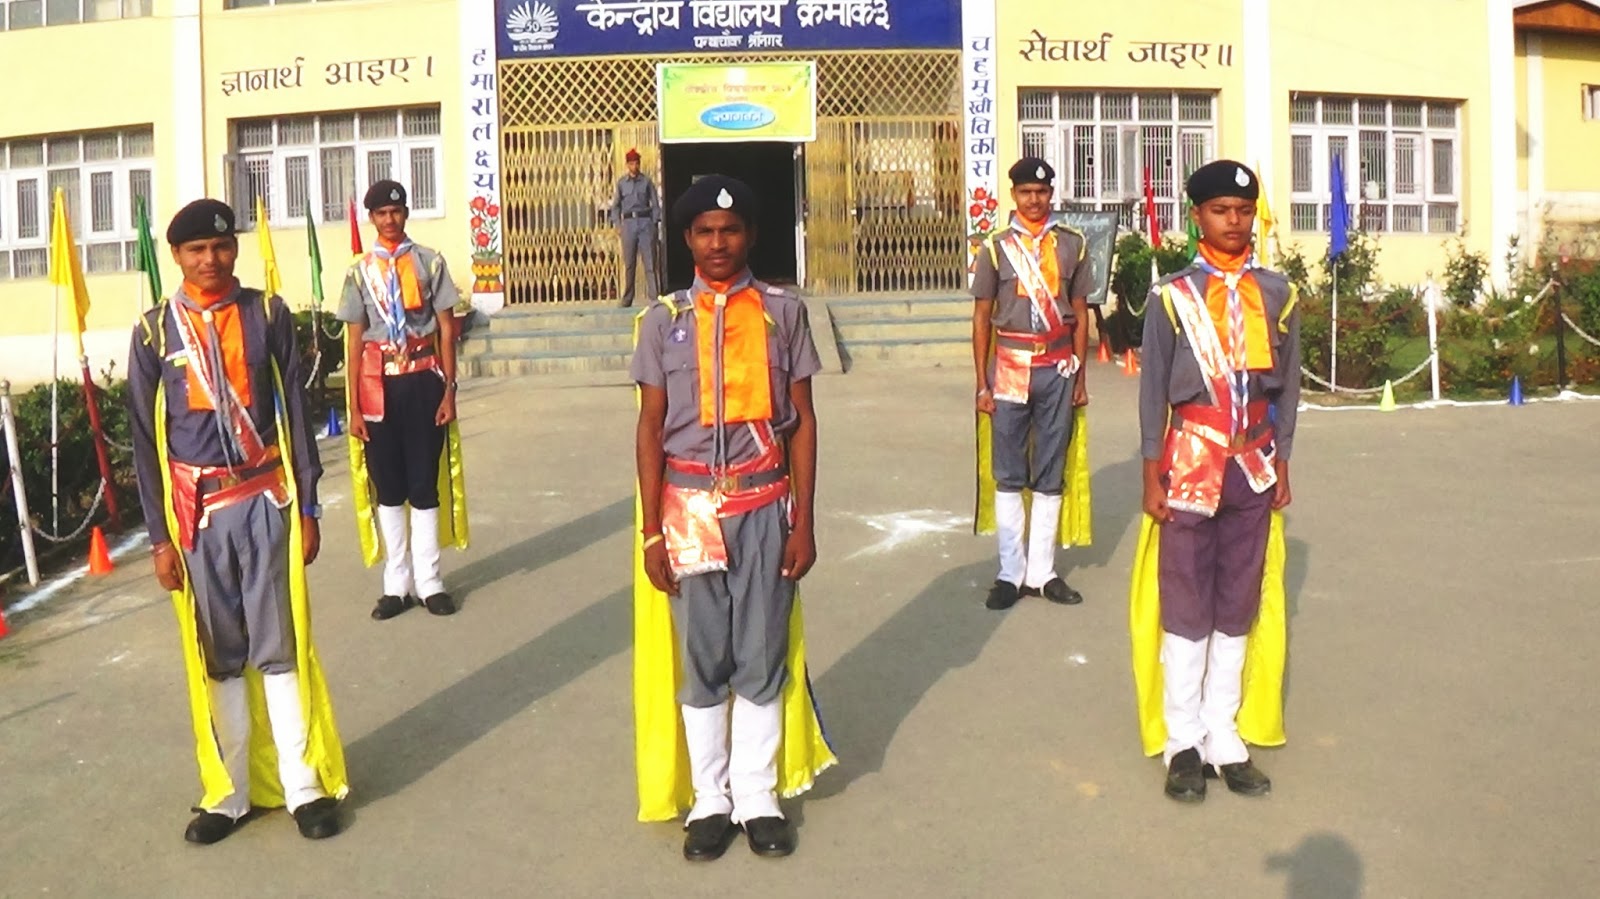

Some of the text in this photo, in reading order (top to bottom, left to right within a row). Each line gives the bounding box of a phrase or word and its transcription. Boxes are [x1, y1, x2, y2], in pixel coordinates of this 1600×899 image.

[748, 31, 783, 48] श्रीनगर
[1019, 29, 1113, 61] सेवार्थ
[221, 57, 304, 96] ज्ञानार्थ
